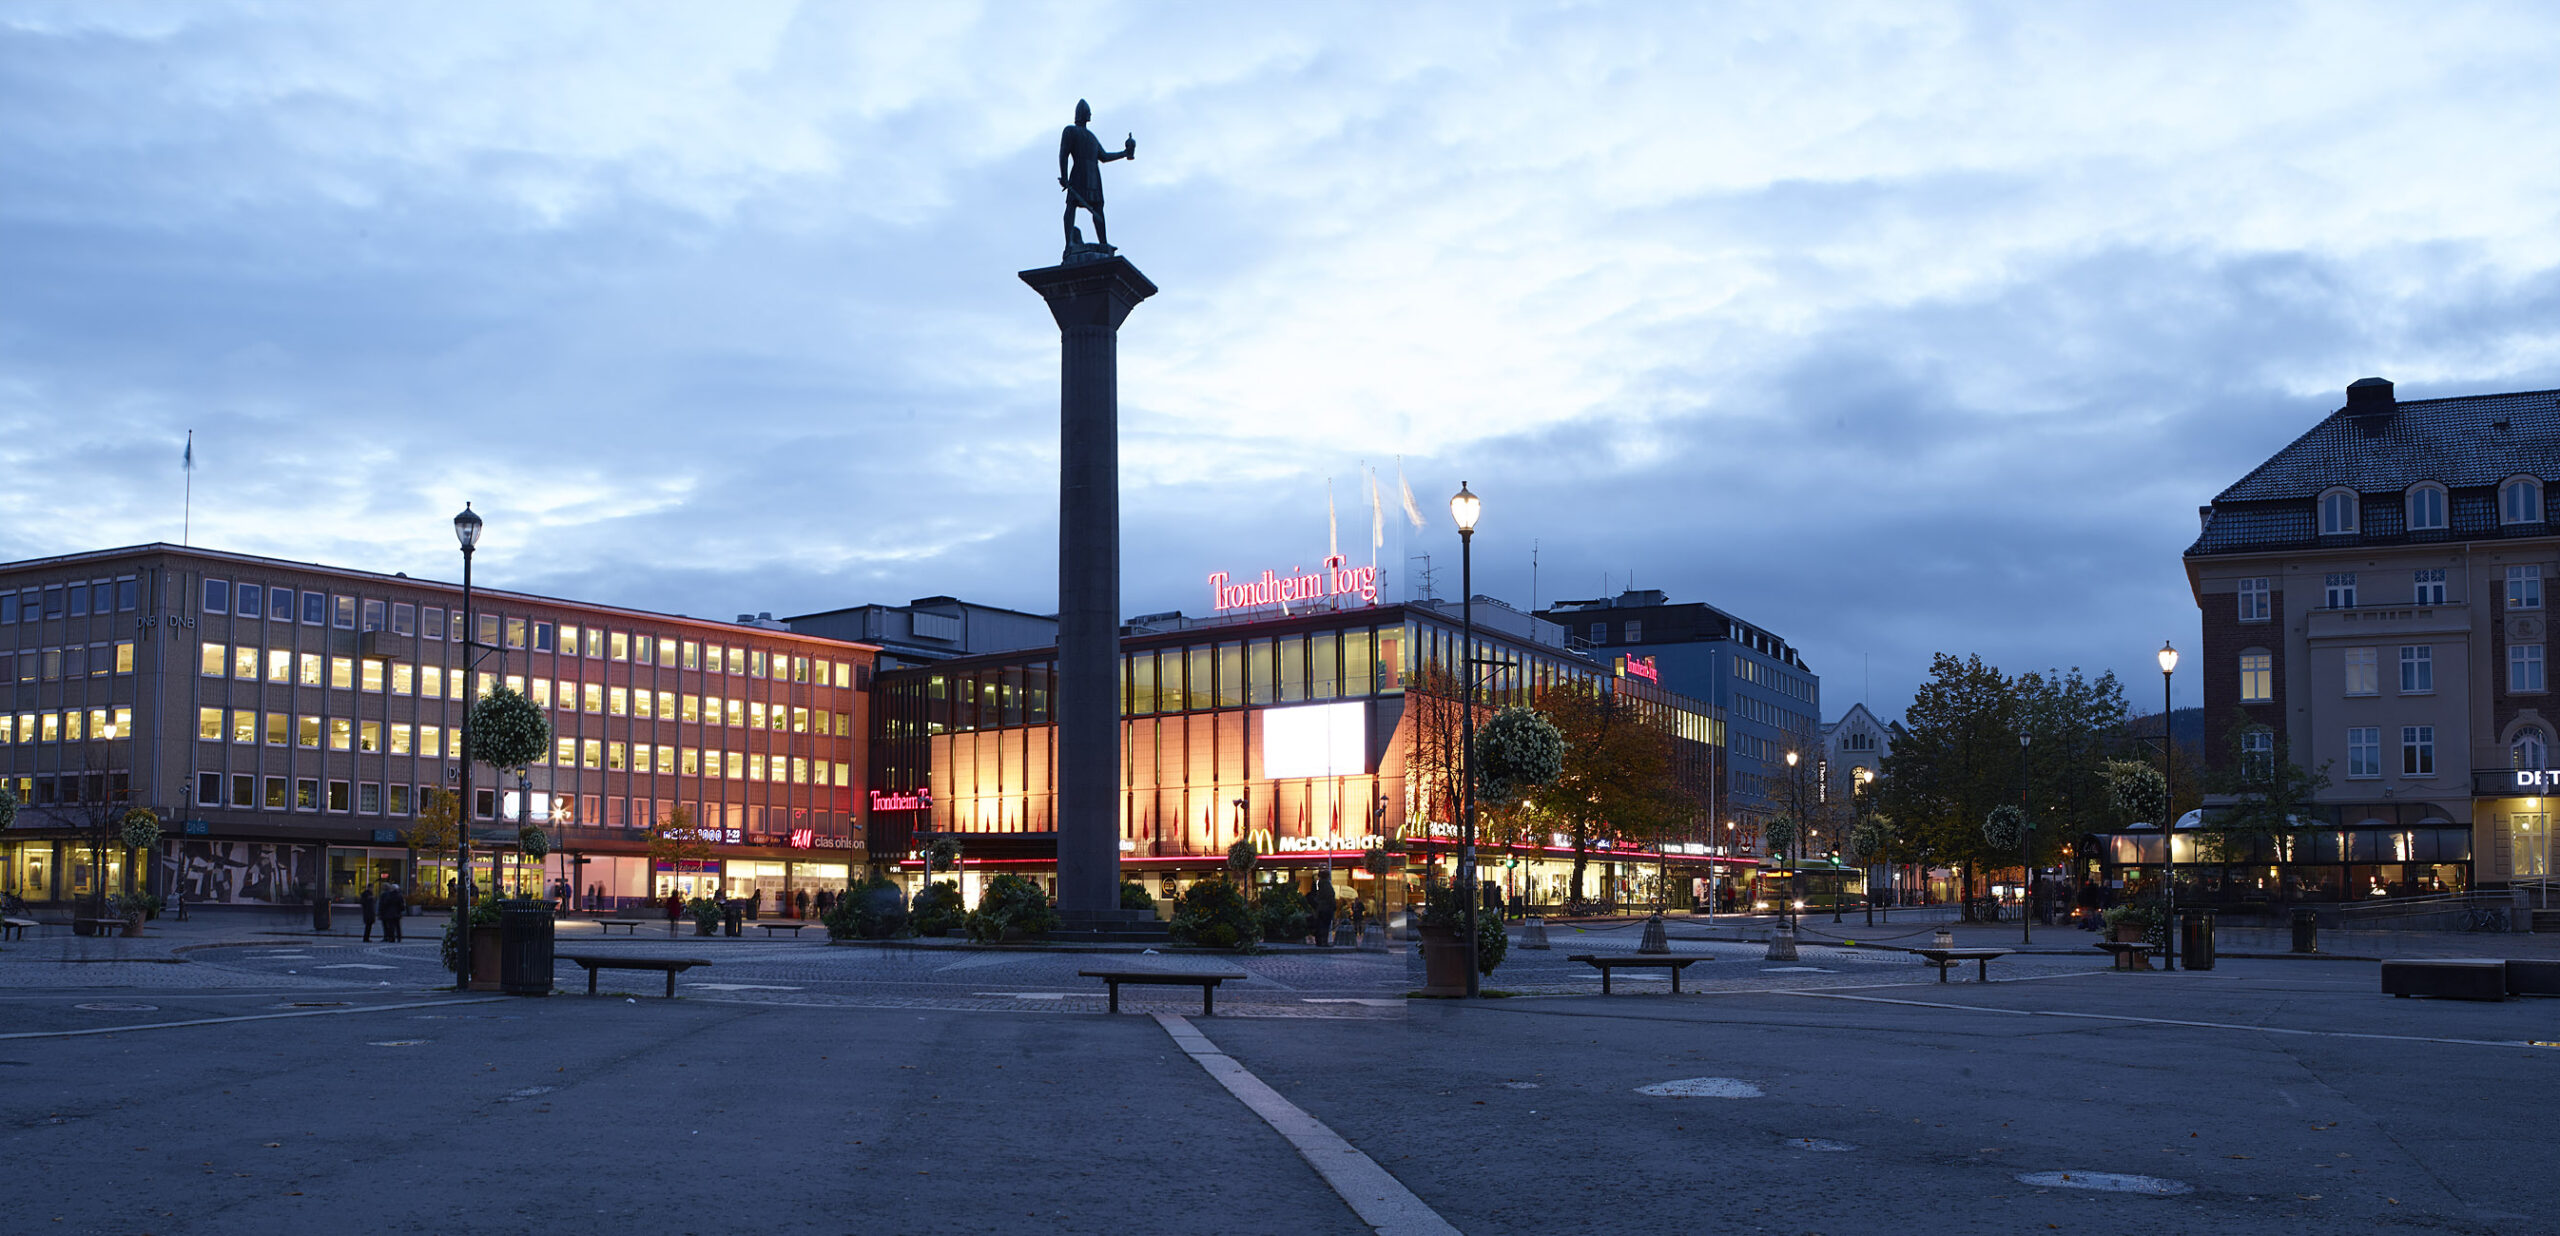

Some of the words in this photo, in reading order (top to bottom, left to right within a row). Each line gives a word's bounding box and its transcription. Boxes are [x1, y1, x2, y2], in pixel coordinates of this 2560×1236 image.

[1208, 566, 1324, 610] Trondheim
[1323, 555, 1377, 601] Torg
[169, 614, 196, 630] DNB
[870, 790, 918, 811] Trondheim
[791, 829, 812, 850] H&M
[814, 837, 834, 849] clas
[834, 838, 865, 849] ohlson
[1278, 834, 1384, 852] McDonald's
